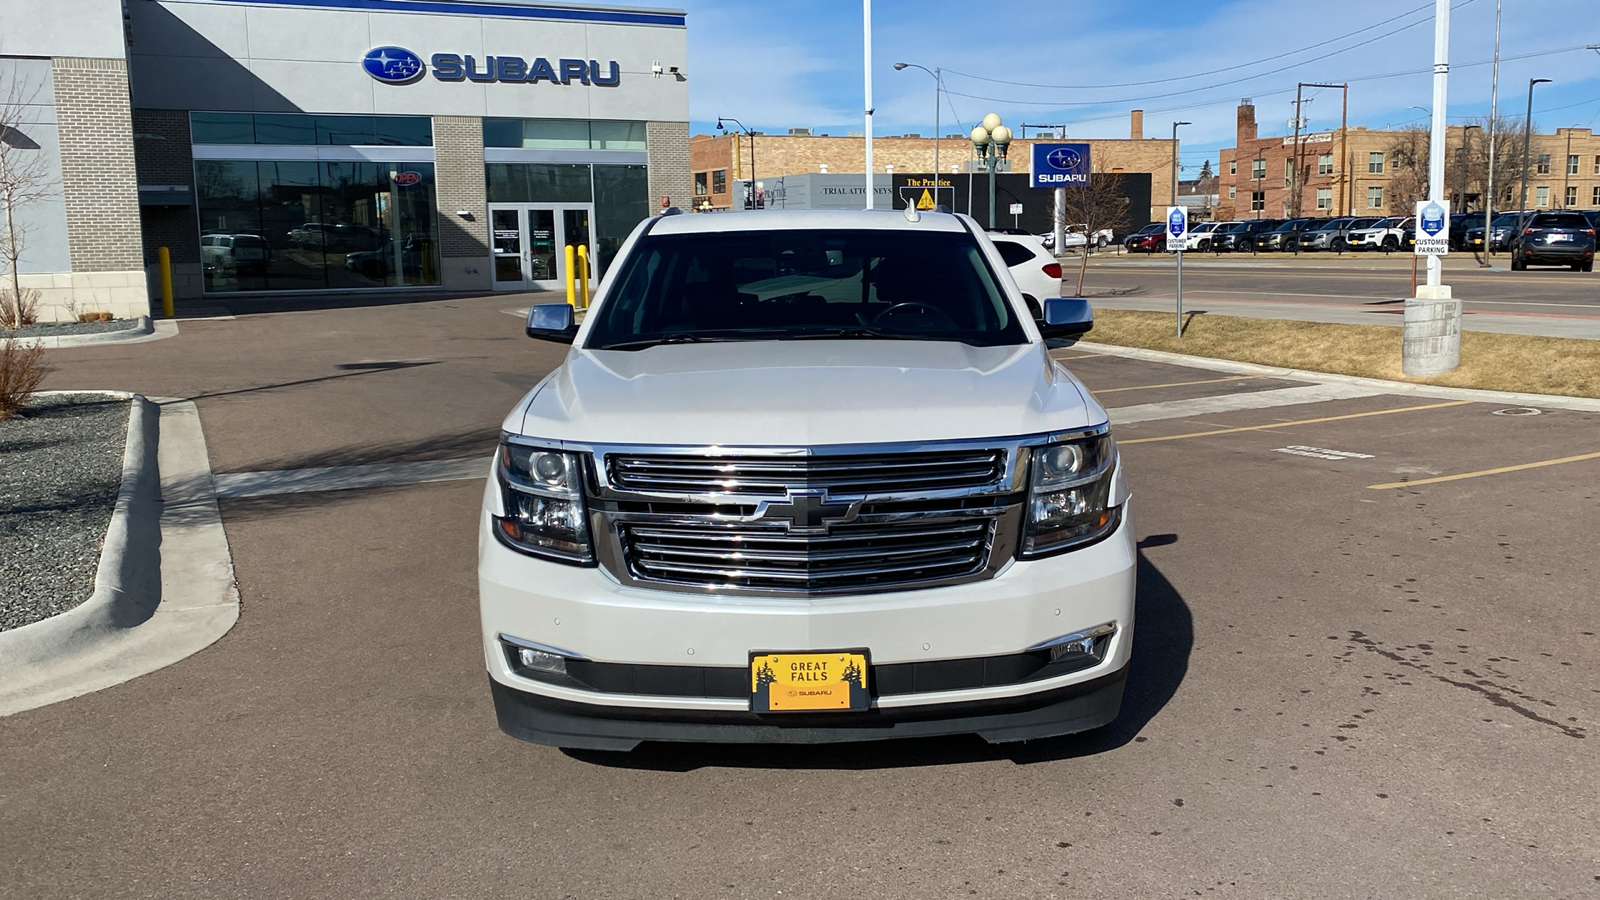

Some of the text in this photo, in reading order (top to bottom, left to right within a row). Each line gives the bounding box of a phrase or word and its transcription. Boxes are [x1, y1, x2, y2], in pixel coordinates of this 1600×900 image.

[431, 53, 620, 86] SUBARU
[395, 173, 419, 184] OPEN
[907, 178, 951, 187] The Pratice
[1038, 174, 1087, 183] SUBARU
[823, 187, 893, 195] TRIAL ATTONEYS
[791, 662, 828, 671] GREAT
[791, 671, 828, 682] FALLS
